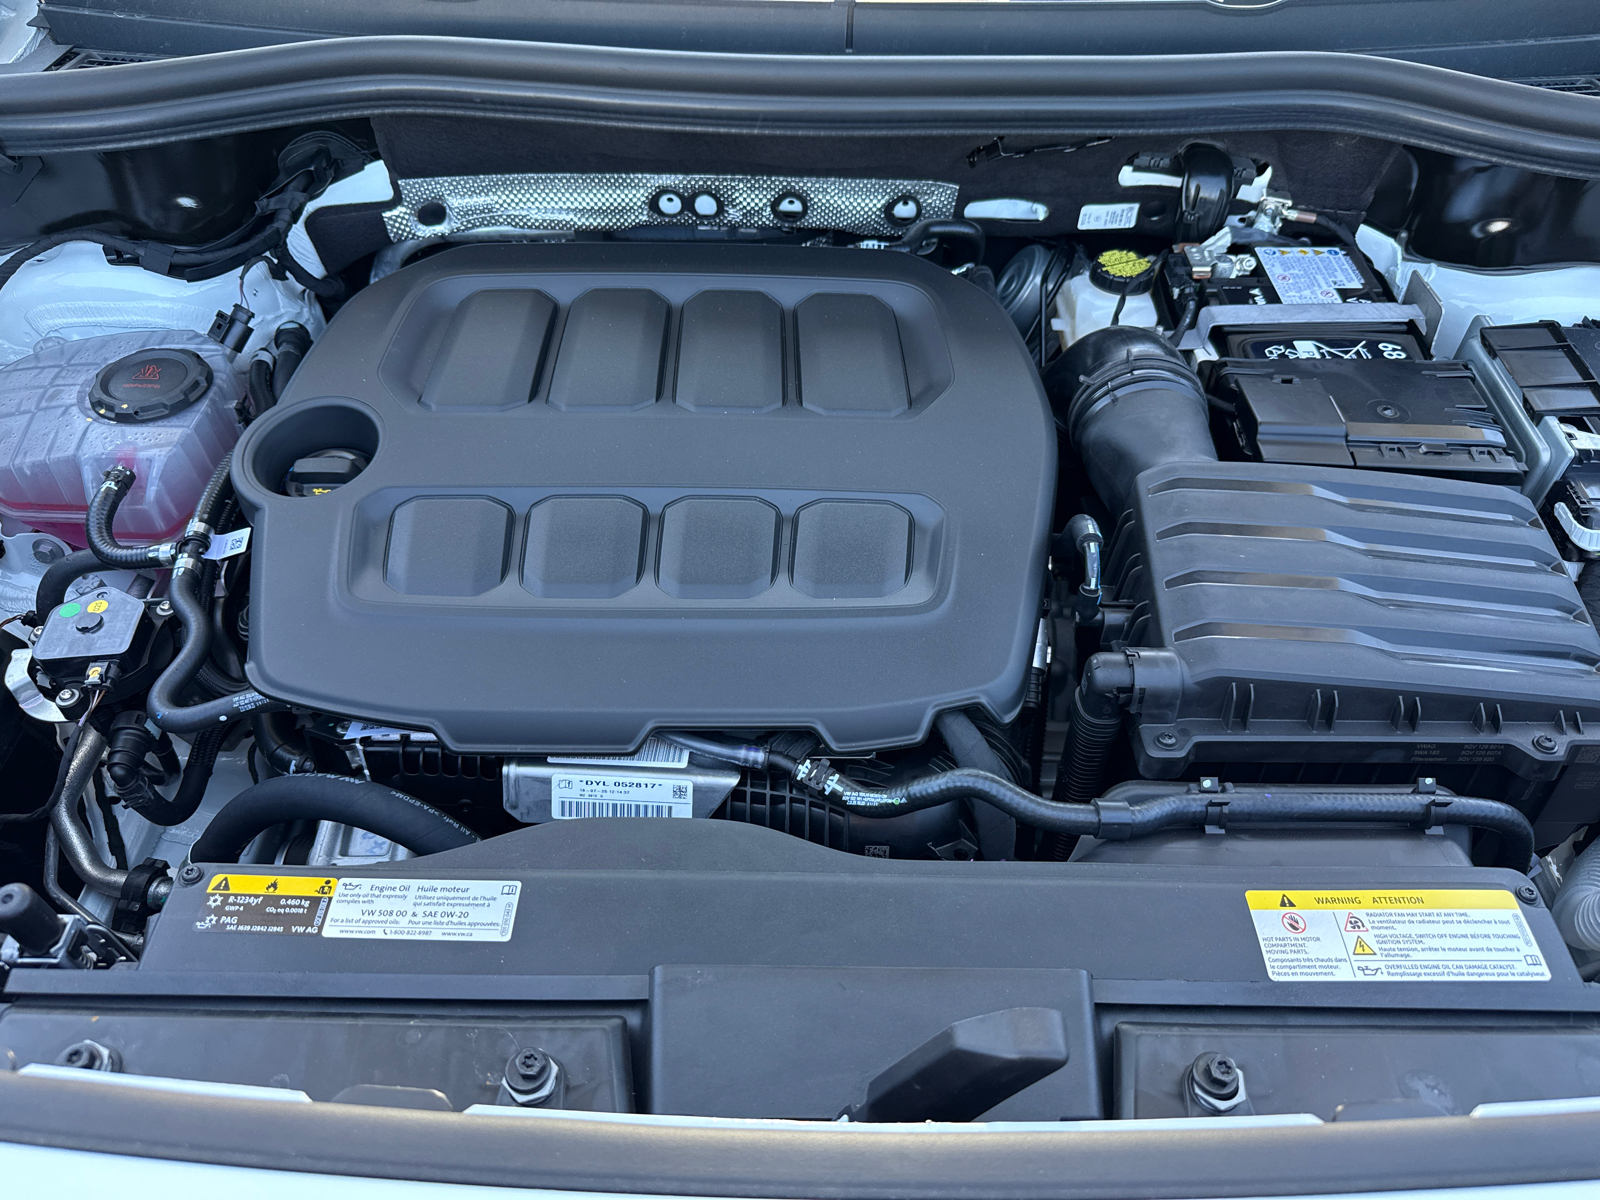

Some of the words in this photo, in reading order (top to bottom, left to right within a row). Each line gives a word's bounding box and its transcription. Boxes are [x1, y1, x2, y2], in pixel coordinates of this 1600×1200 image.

[370, 885, 397, 893] Engine
[228, 896, 263, 906] R-1234yf
[301, 899, 310, 907] kg
